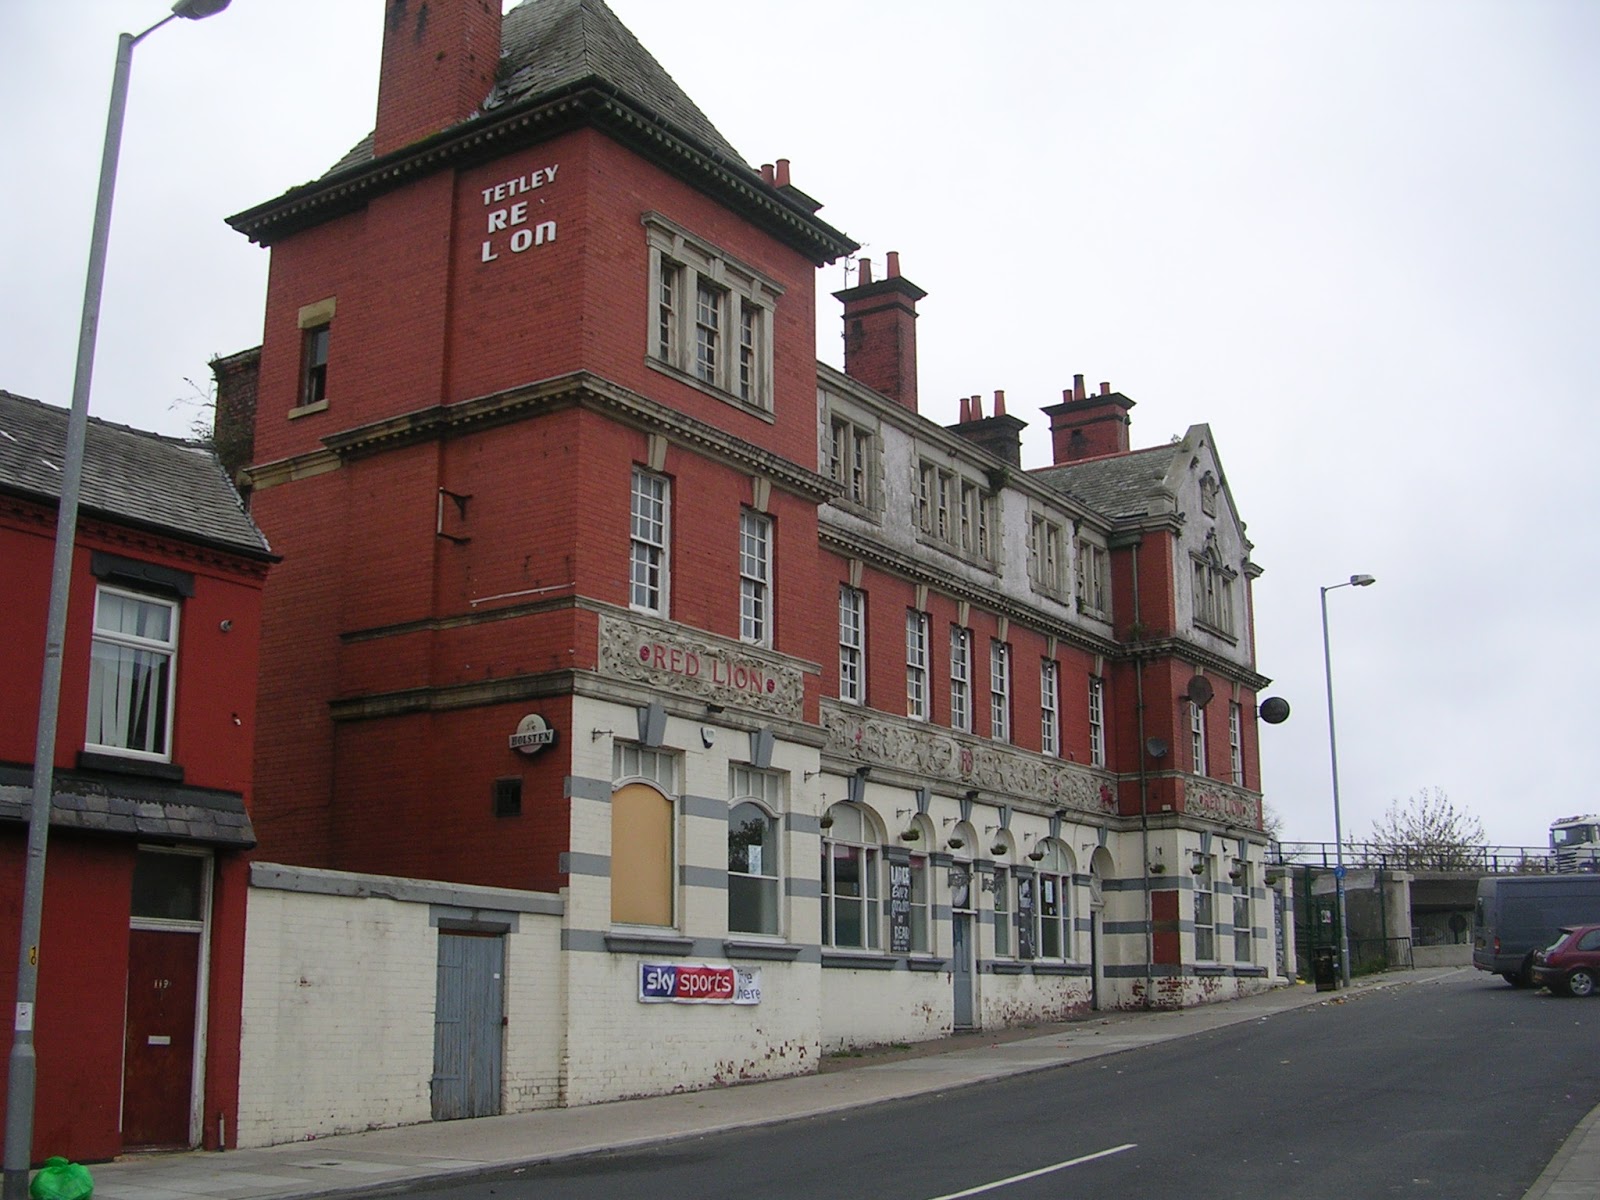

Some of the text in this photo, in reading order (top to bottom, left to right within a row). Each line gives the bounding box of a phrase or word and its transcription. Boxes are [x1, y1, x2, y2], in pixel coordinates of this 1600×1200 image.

[482, 164, 559, 206] TETLEY
[653, 643, 763, 694] RED LION
[511, 731, 551, 747] HOLSTEN
[646, 968, 732, 995] sky sports
